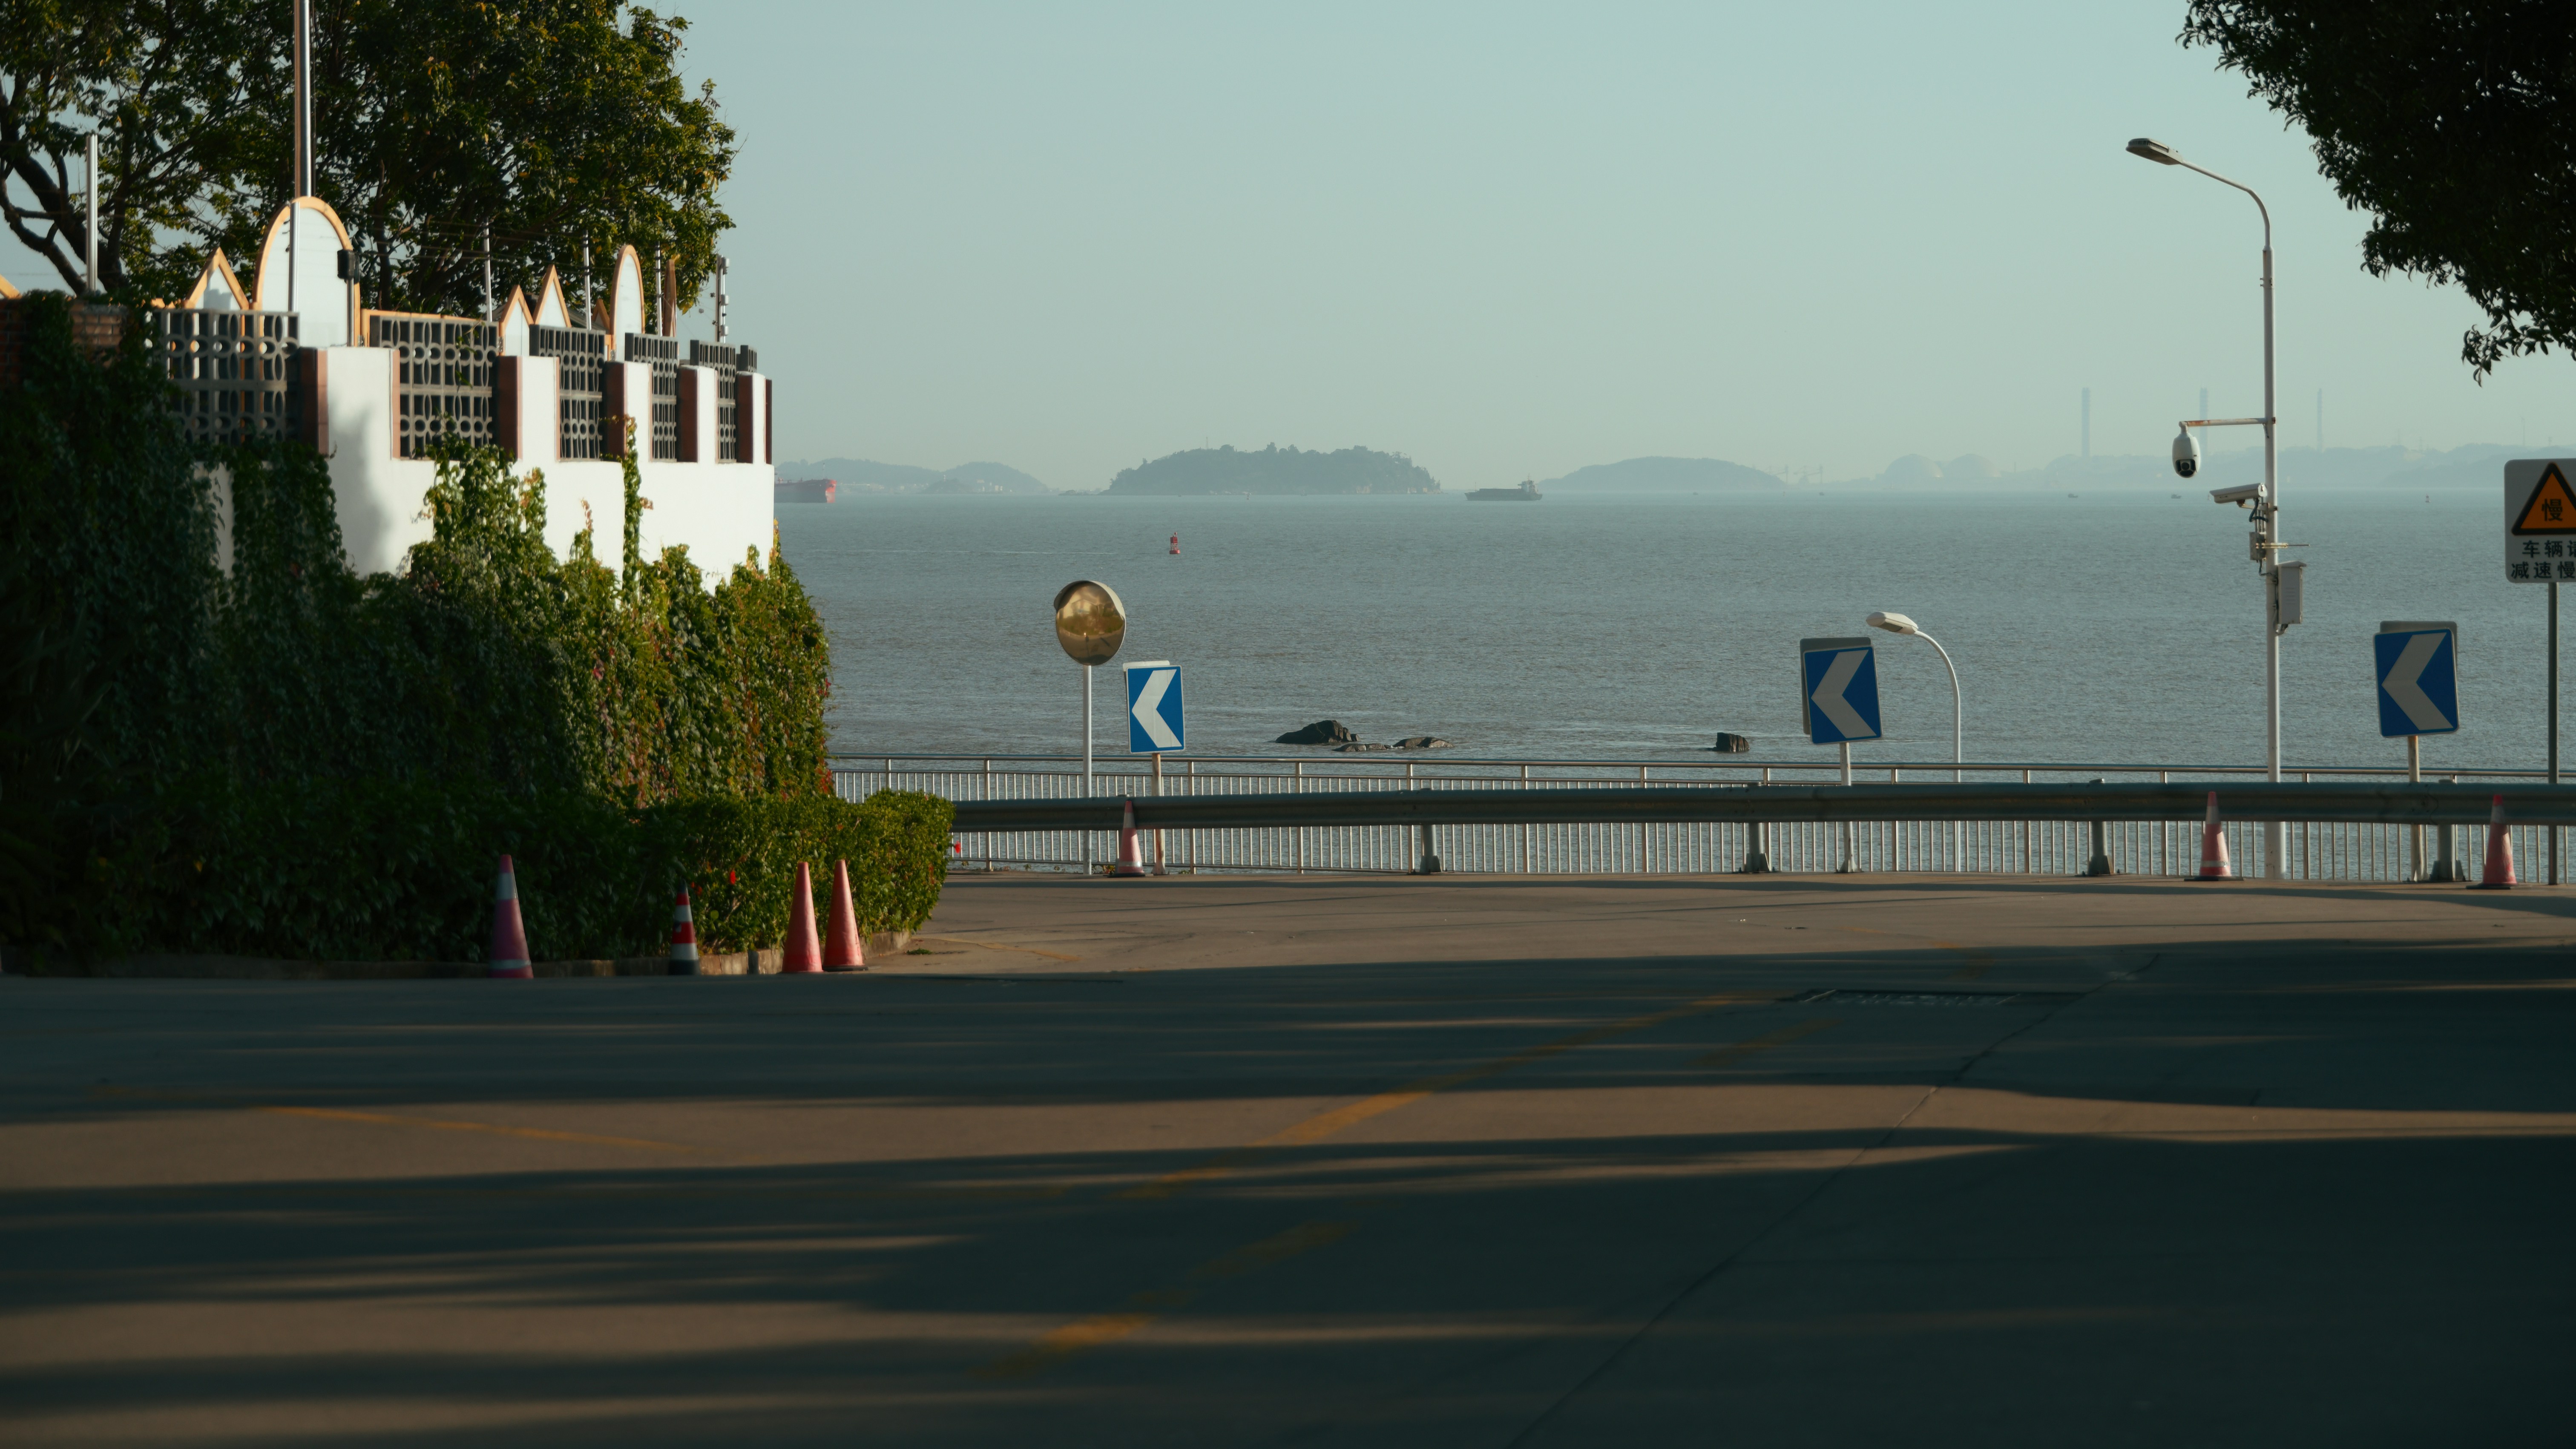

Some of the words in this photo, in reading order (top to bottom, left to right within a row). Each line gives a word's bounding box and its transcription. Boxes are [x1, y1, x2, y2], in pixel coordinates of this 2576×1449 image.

[2542, 499, 2563, 521] 慢
[2511, 561, 2575, 579] 减速慢
